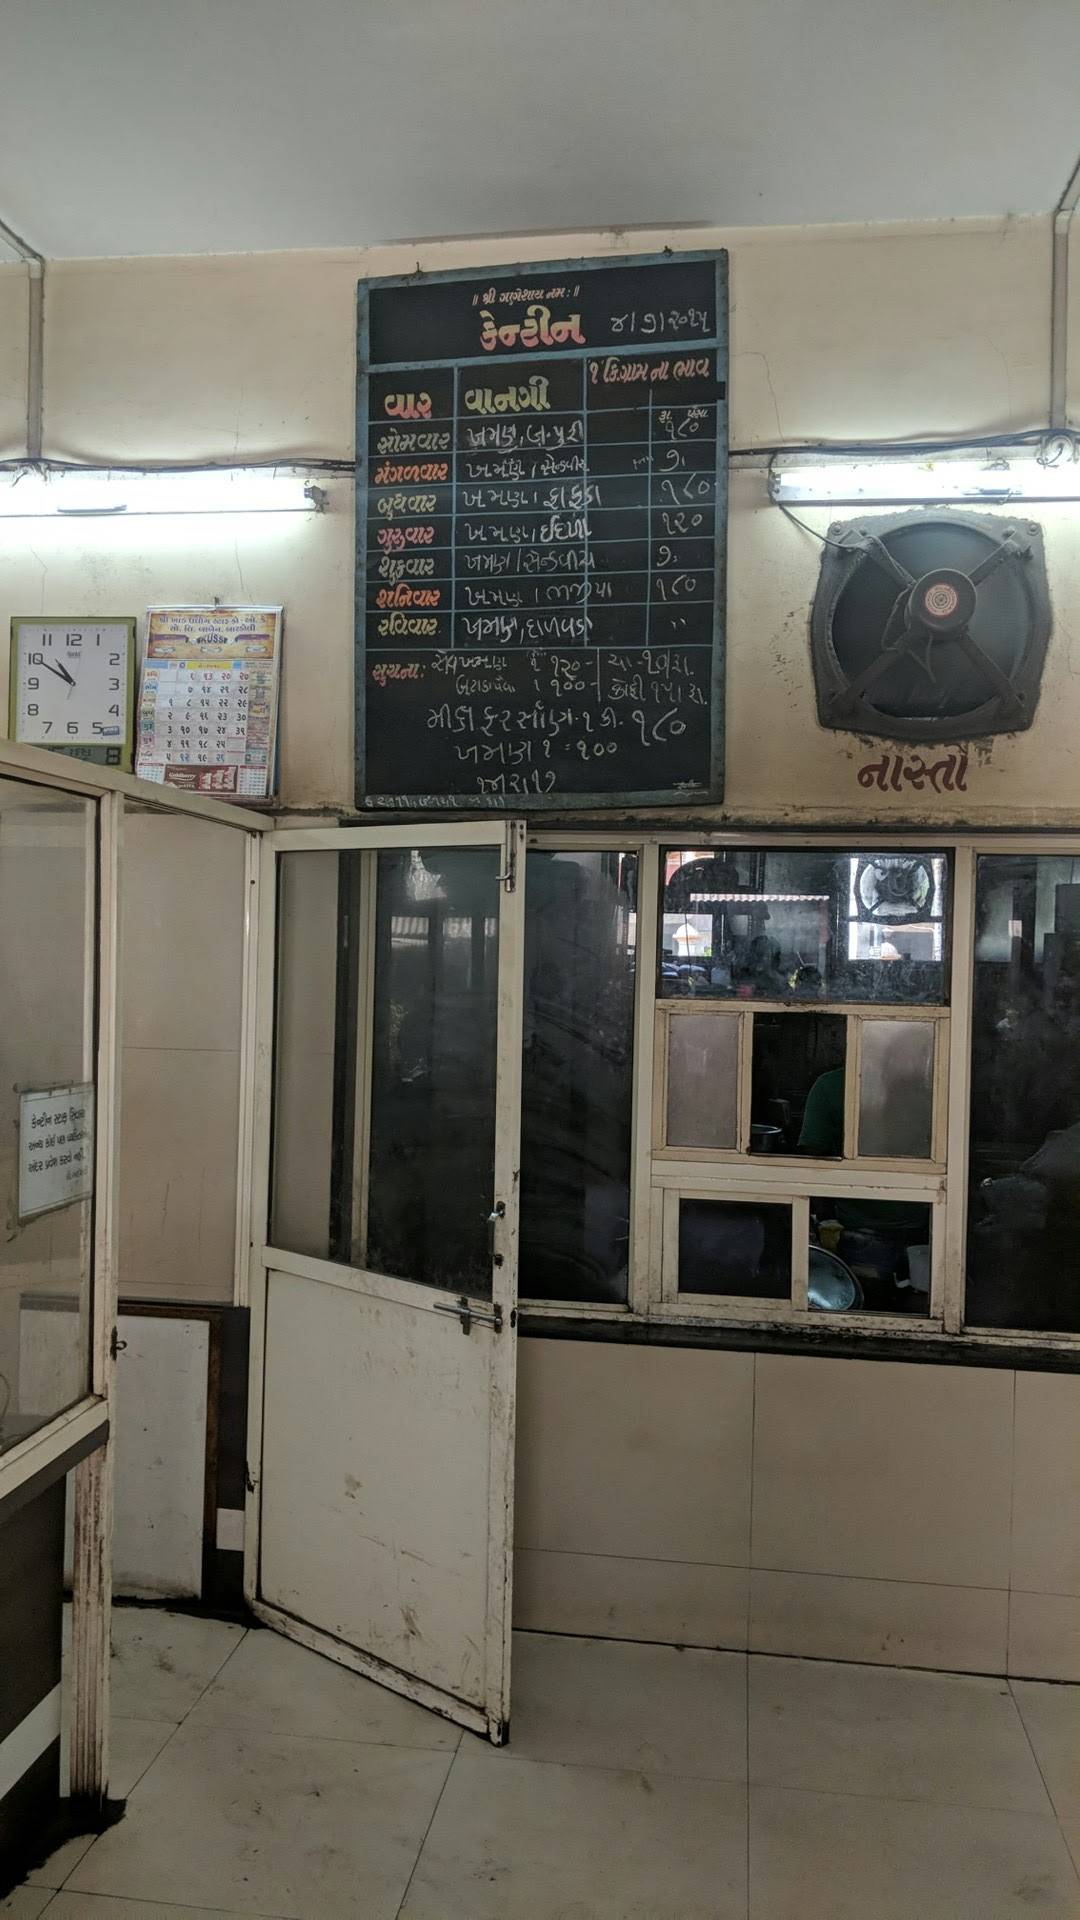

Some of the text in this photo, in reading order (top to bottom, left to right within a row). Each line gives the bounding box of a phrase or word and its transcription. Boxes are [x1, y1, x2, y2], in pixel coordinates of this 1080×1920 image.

[482, 288, 496, 304] શ્રી
[499, 288, 544, 306] ગણેશાય
[480, 304, 586, 351] કેન્ટીન
[650, 364, 668, 380] ના
[672, 357, 711, 379] ભાવ
[384, 391, 432, 419] વાર
[465, 376, 552, 415] વાનગી
[377, 427, 451, 455] સોમવાર
[374, 460, 449, 485] મંગળવાર
[377, 493, 437, 520] બુધવાર
[462, 490, 528, 508] ખમણ
[378, 556, 435, 586] શુક્રવાર
[376, 583, 441, 609] શનિવાર
[377, 611, 438, 636] રવિવાર
[42, 633, 101, 646] 11 12 1
[28, 652, 120, 665] 10 2
[28, 677, 120, 691] 9 3
[27, 703, 119, 717] 8 4
[42, 721, 53, 734] 7
[67, 722, 78, 734] 6
[92, 722, 103, 734] 5
[181, 726, 190, 734] ૧૦
[455, 741, 532, 765] ખમણ
